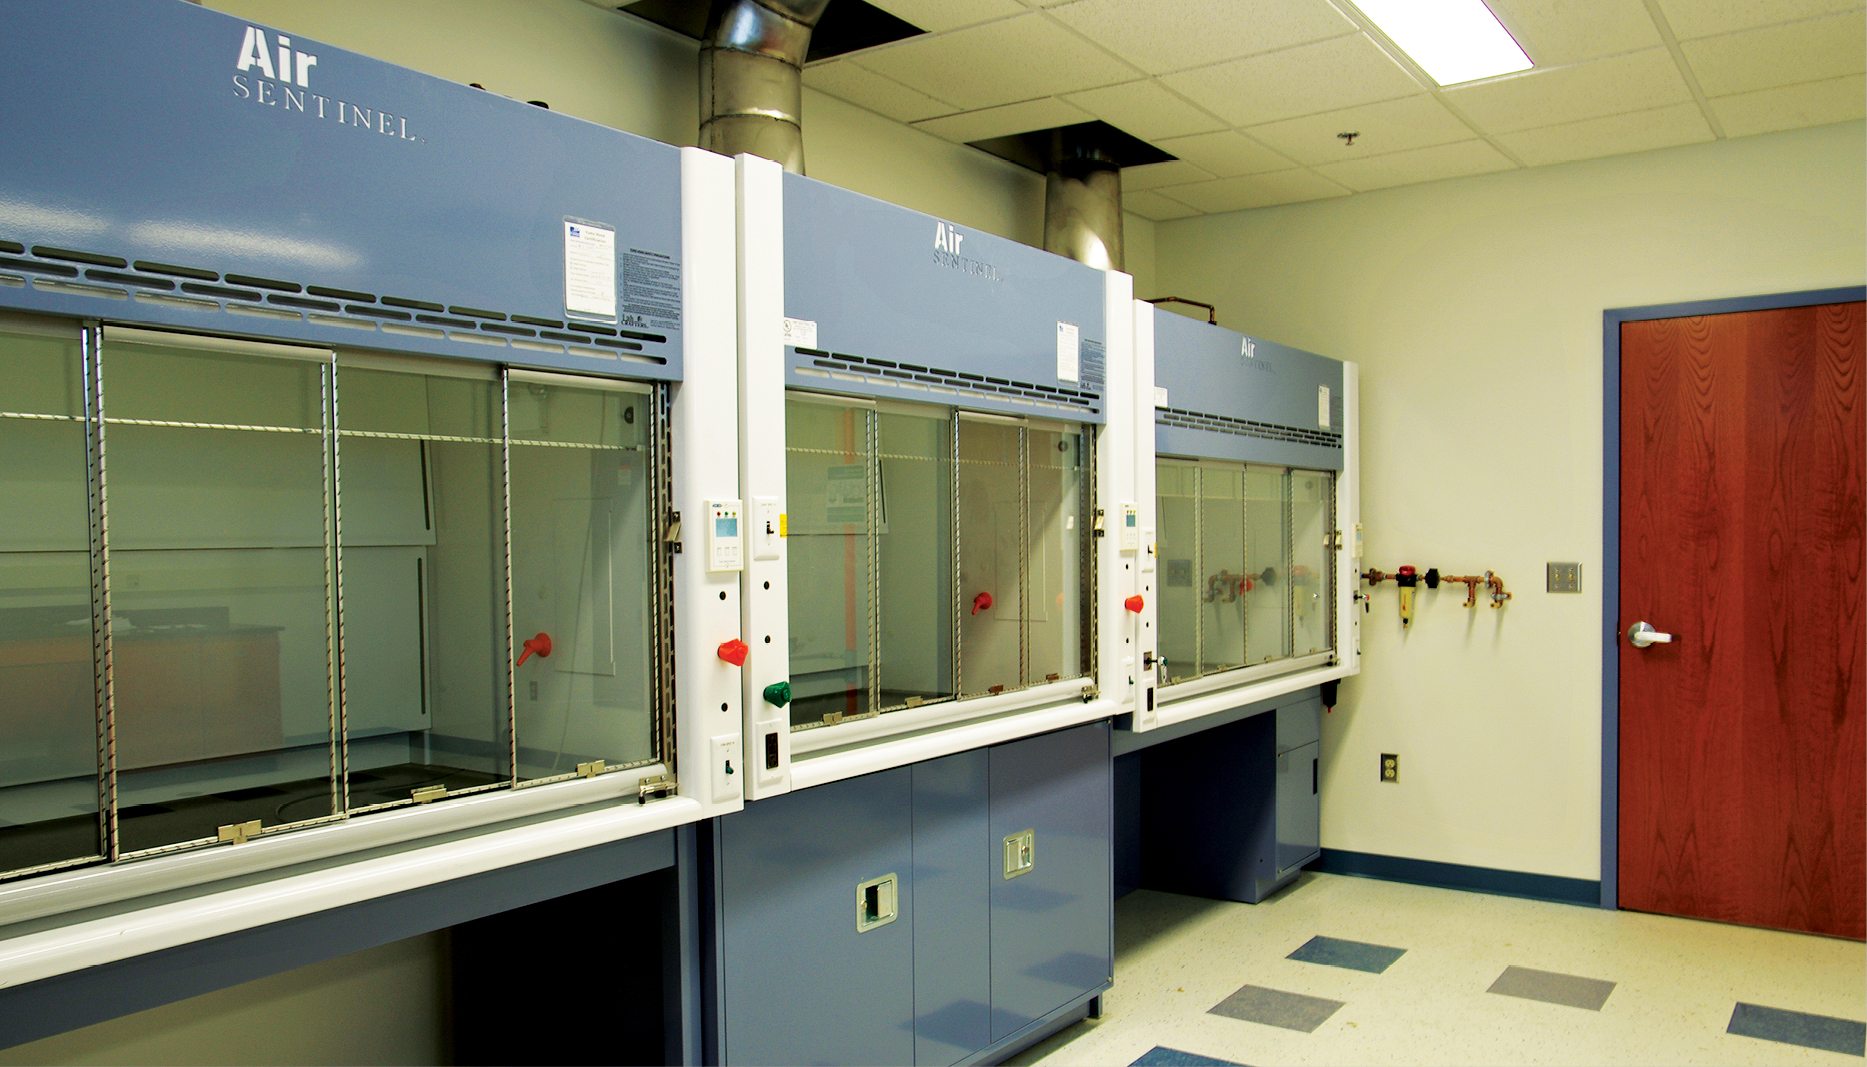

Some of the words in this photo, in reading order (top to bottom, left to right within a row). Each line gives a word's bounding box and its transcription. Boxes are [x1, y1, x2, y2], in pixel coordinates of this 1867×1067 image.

[236, 25, 318, 88] Air
[232, 73, 417, 141] SENTINEL
[934, 220, 964, 256] Air
[1241, 336, 1256, 359] Air
